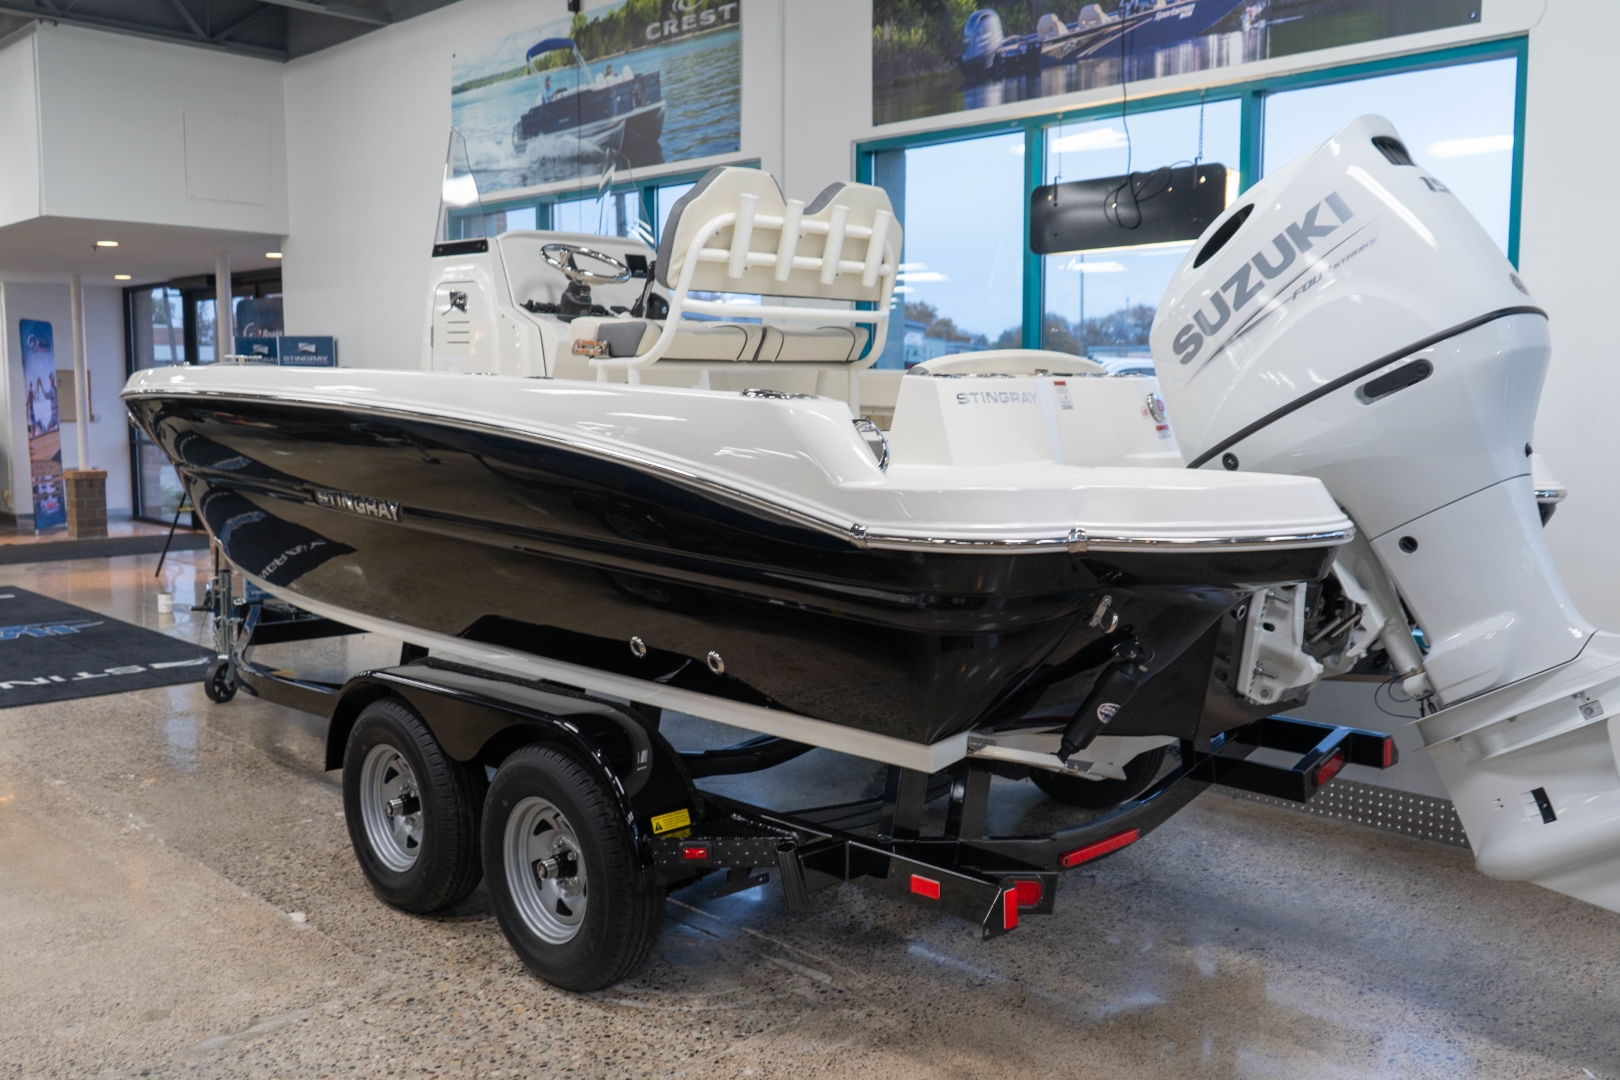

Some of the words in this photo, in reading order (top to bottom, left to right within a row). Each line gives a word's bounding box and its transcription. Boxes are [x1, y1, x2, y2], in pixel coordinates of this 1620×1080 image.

[645, 2, 738, 40] CREST
[1332, 235, 1378, 270] STROKE
[1172, 191, 1355, 365] SUZUKI
[955, 391, 1037, 405] STINGRAY
[317, 488, 401, 521] STINGRAY
